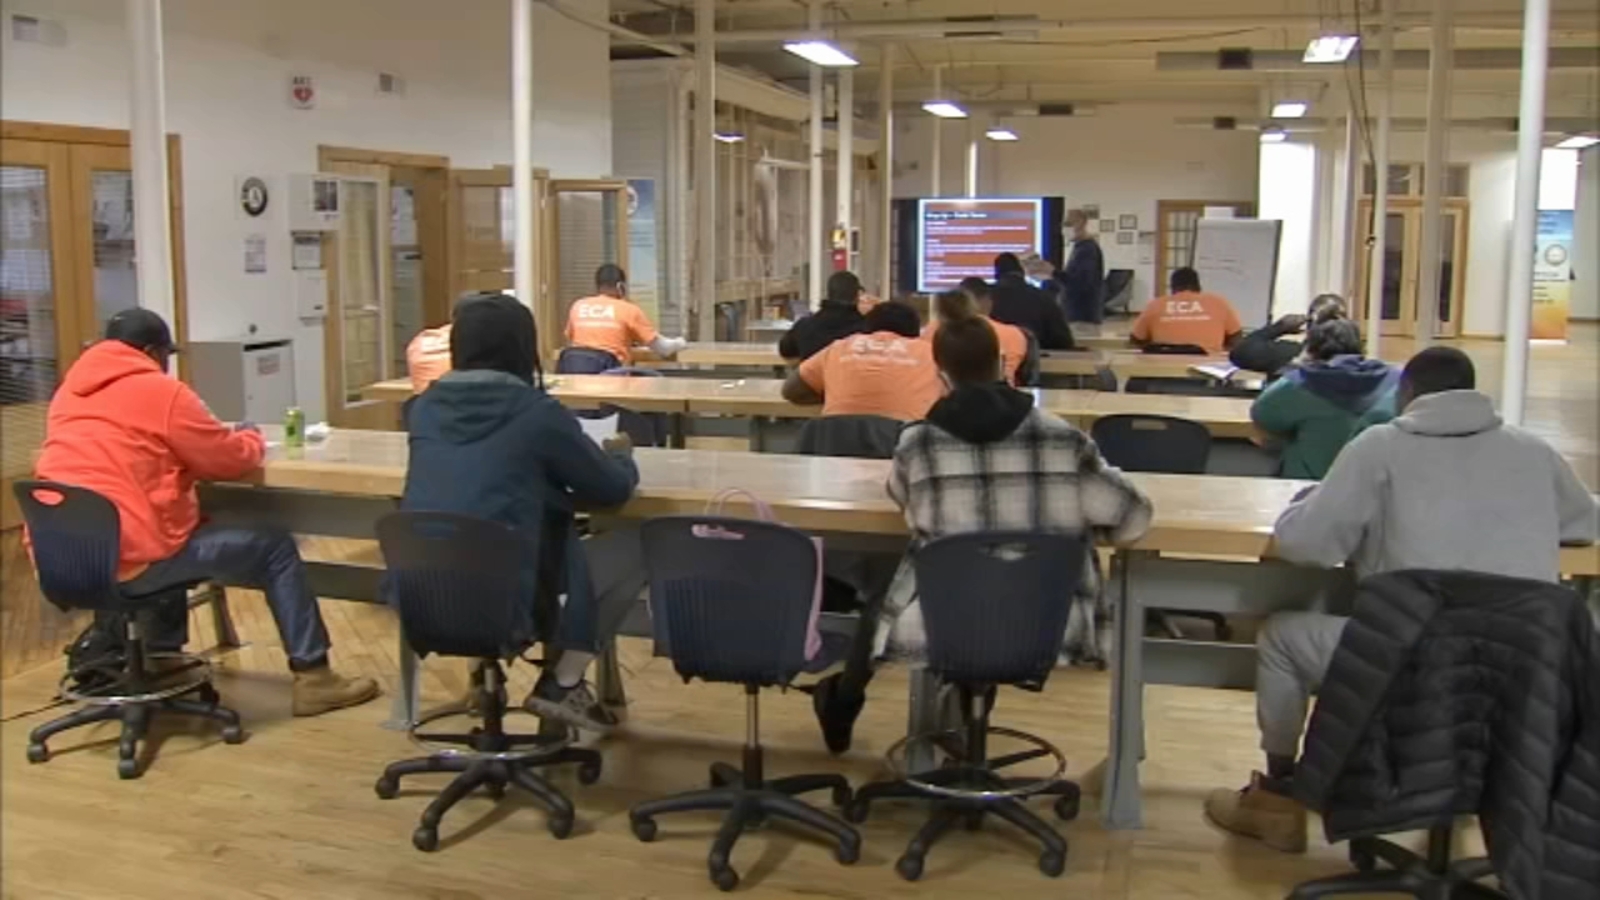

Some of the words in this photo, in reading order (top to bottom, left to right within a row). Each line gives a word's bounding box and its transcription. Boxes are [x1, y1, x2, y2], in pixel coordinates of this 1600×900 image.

[579, 303, 615, 319] ECA
[1166, 301, 1203, 314] ECA
[853, 339, 907, 354] ECA
